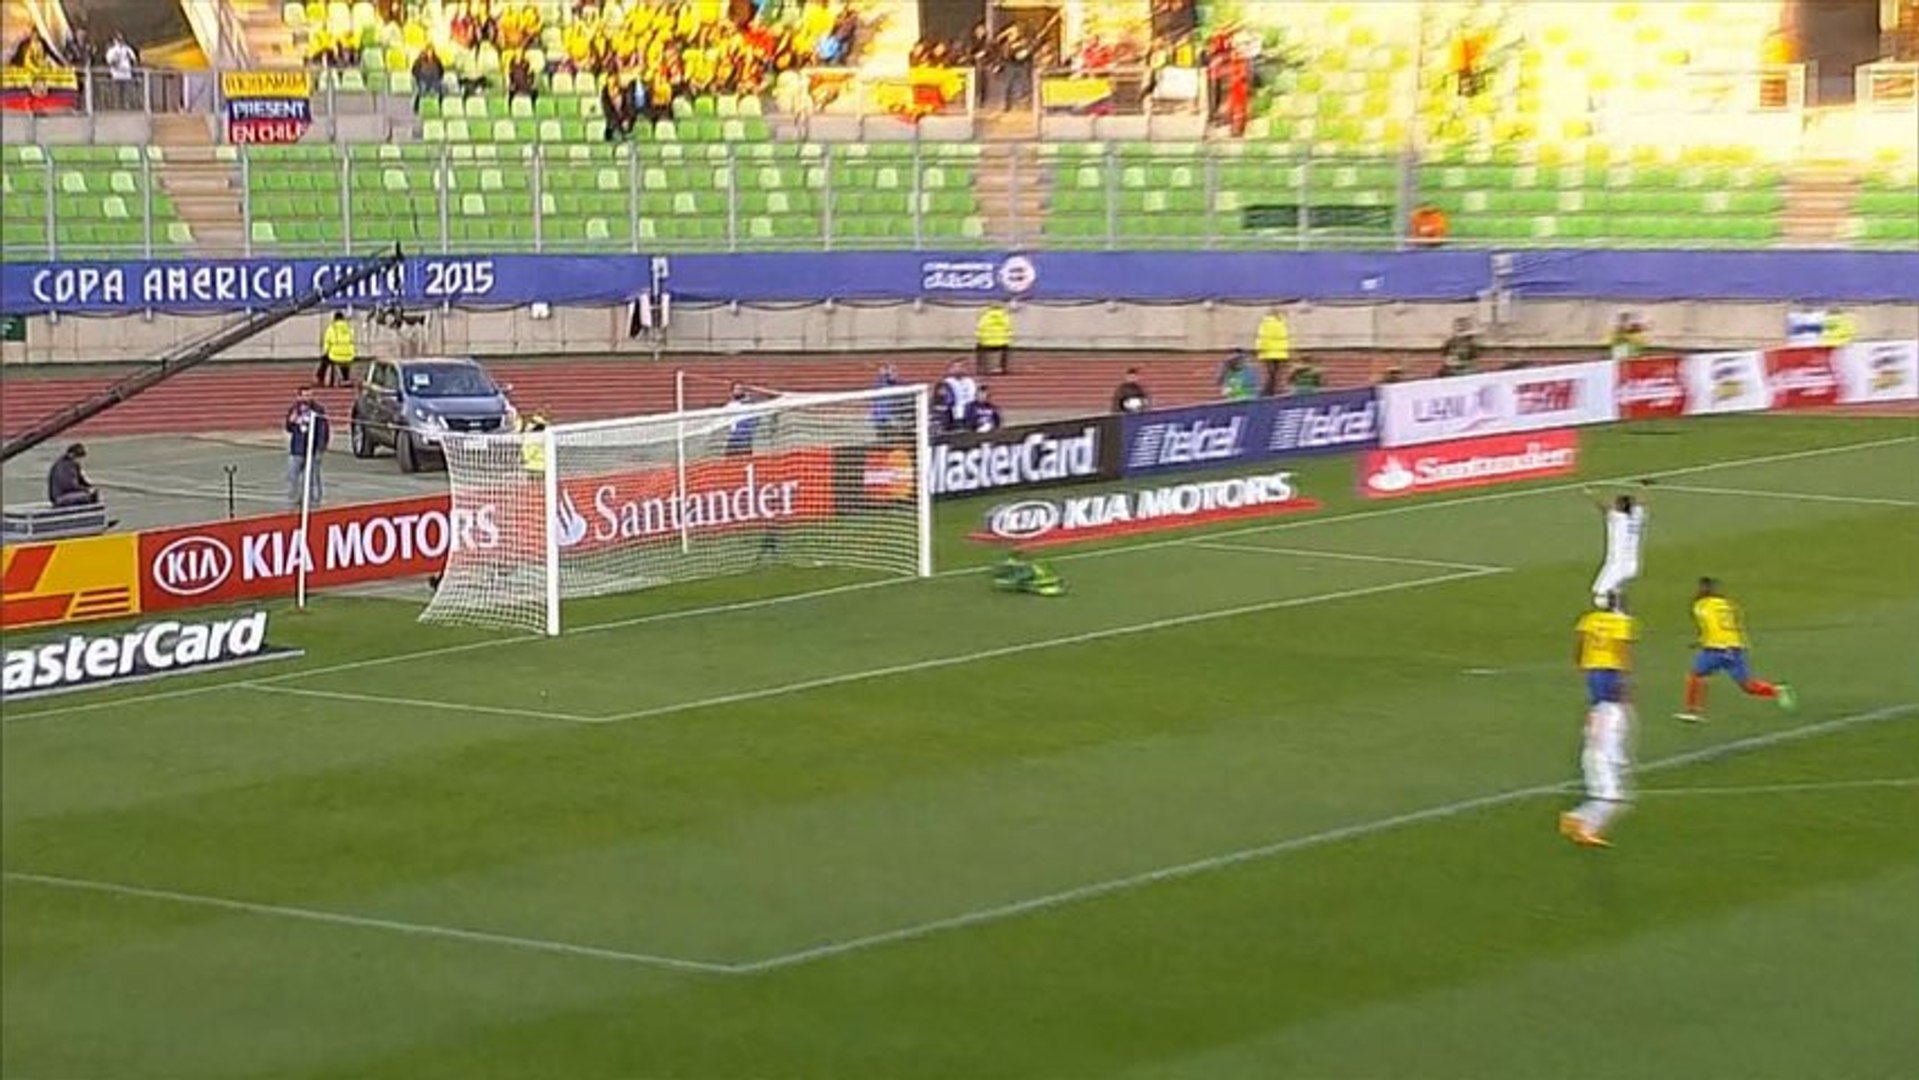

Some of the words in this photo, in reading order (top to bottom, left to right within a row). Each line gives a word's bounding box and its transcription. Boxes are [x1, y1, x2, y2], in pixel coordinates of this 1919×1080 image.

[232, 123, 255, 143] EN
[33, 268, 124, 302] COPA
[144, 265, 294, 301] AMERICA
[425, 261, 494, 295] 2015
[928, 427, 1096, 494] MasterCard
[595, 462, 799, 541] Santander
[1062, 494, 1130, 529] KIA
[1136, 472, 1294, 521] MOTORS
[167, 548, 221, 584] KIA
[242, 527, 314, 580] KIA
[326, 504, 499, 570] MOTORS
[2, 611, 267, 691] asterCard
